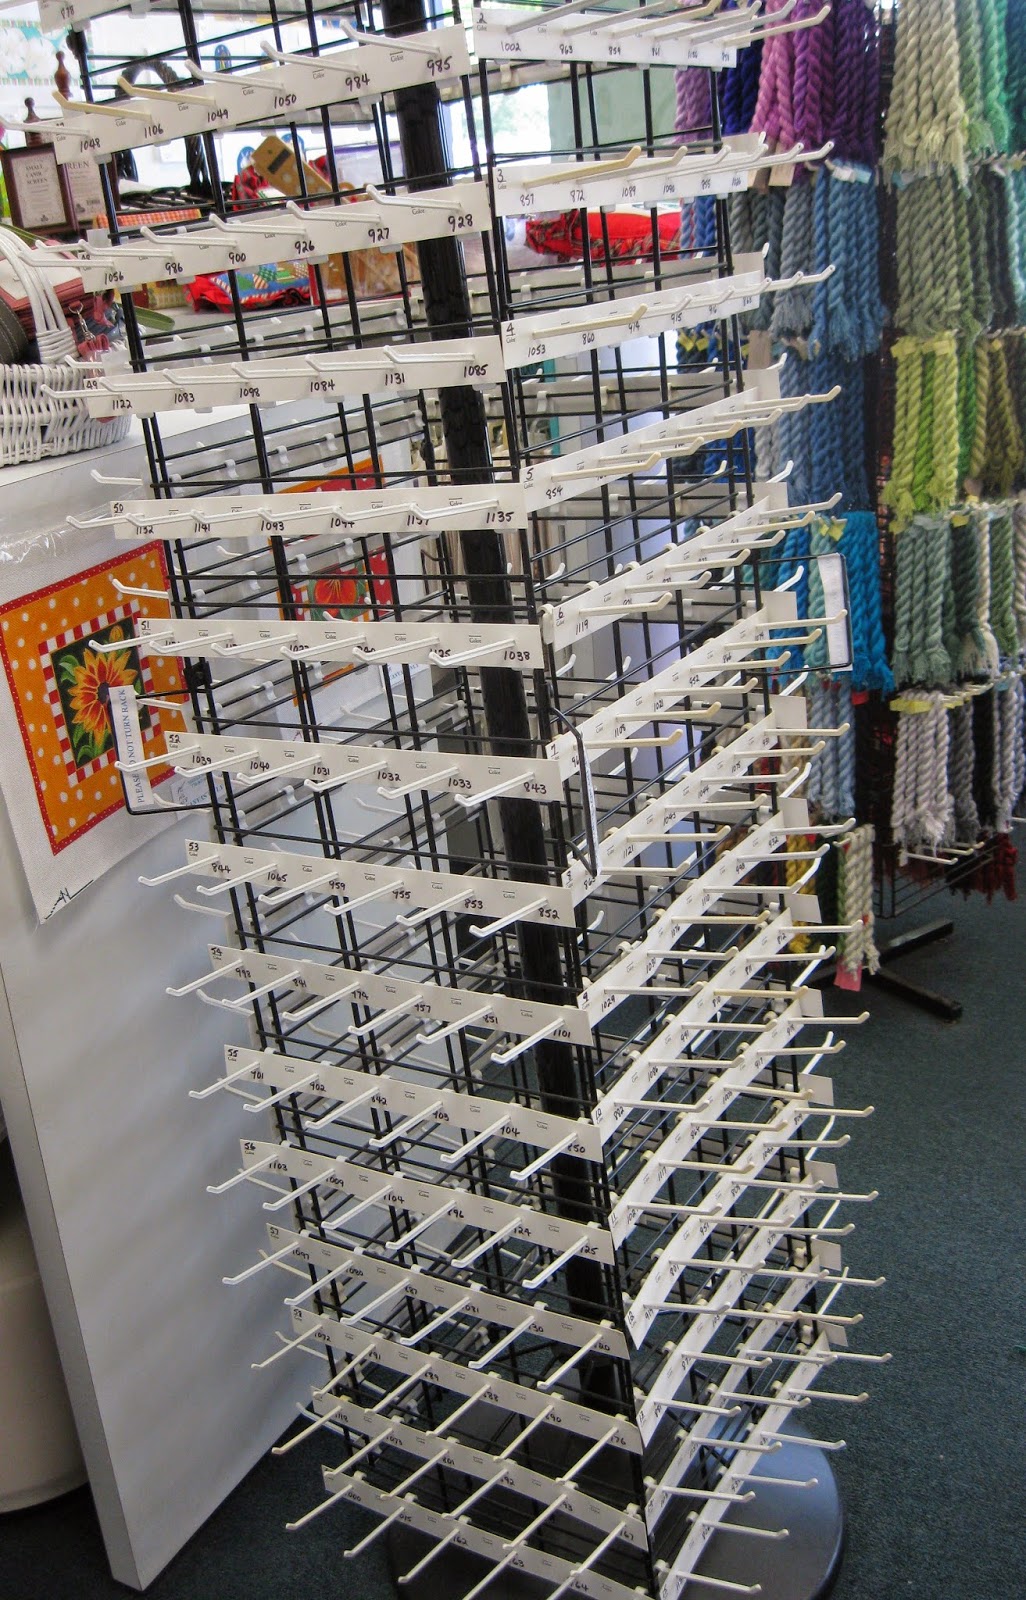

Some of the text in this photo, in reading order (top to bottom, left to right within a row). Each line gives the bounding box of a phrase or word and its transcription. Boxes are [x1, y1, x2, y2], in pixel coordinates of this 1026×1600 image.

[476, 13, 488, 24] 2
[500, 42, 522, 52] 1002
[560, 44, 574, 54] 863
[80, 56, 452, 153] 1048 1106 1049 1050 984 985
[496, 169, 506, 181] 3
[520, 194, 534, 206] 857
[570, 190, 585, 202] 872
[104, 271, 124, 286] 1056
[165, 262, 184, 275] 986
[228, 252, 246, 264] 900
[294, 240, 314, 255] 926
[368, 228, 390, 243] 927
[448, 213, 473, 232] 928
[506, 322, 514, 336] 4
[528, 344, 546, 358] 1053
[582, 332, 595, 345] 860
[86, 364, 489, 410] 49 1122 1083 1098 1084 1131 1085
[526, 468, 564, 499] 5 854
[114, 503, 124, 512] 50
[260, 521, 284, 531] 1093
[486, 511, 514, 524] 1135
[558, 607, 588, 635] 6 1119
[141, 620, 151, 630] 51
[504, 650, 530, 662] 1038
[118, 690, 128, 712] RACK
[122, 716, 132, 738] TURN
[126, 741, 135, 758] NOT
[169, 734, 547, 794] 52 1039 1040 1031 1032 1033 843
[572, 756, 580, 768] 96
[132, 774, 144, 803] PLEASE
[624, 844, 634, 859] 1121
[188, 842, 199, 850] 53
[212, 863, 232, 874] 844
[267, 872, 288, 882] 1065
[328, 880, 346, 890] 959
[464, 899, 484, 909] 853
[538, 908, 560, 919] 852
[602, 995, 616, 1012] 1029
[553, 1028, 571, 1038] 1101
[228, 1049, 238, 1057] 55
[268, 1162, 288, 1172] 1103
[384, 1194, 404, 1204] 1104
[501, 1476, 515, 1486] 92
[560, 1502, 574, 1511] 93
[508, 1557, 524, 1568] 63
